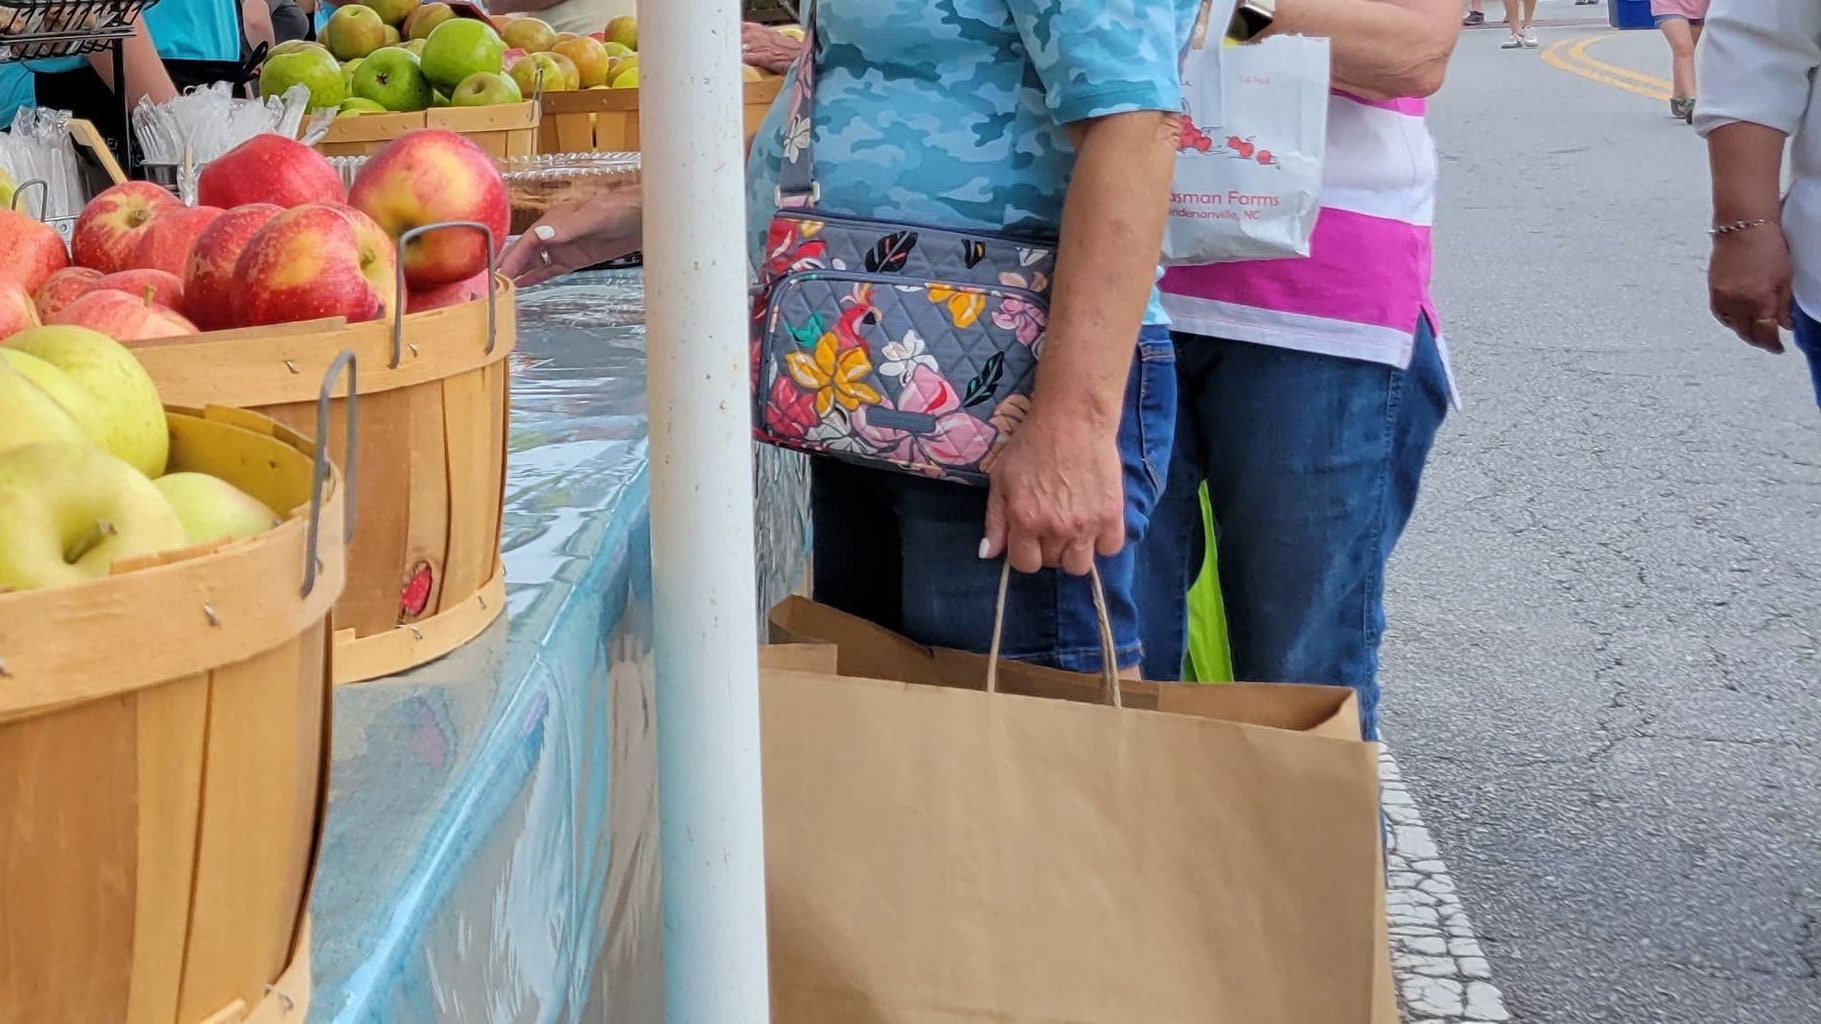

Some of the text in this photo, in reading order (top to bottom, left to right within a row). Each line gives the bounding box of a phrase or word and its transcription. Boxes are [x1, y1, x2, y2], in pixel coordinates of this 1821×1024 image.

[1170, 190, 1280, 207] asman Farms
[1244, 211, 1261, 220] NC
